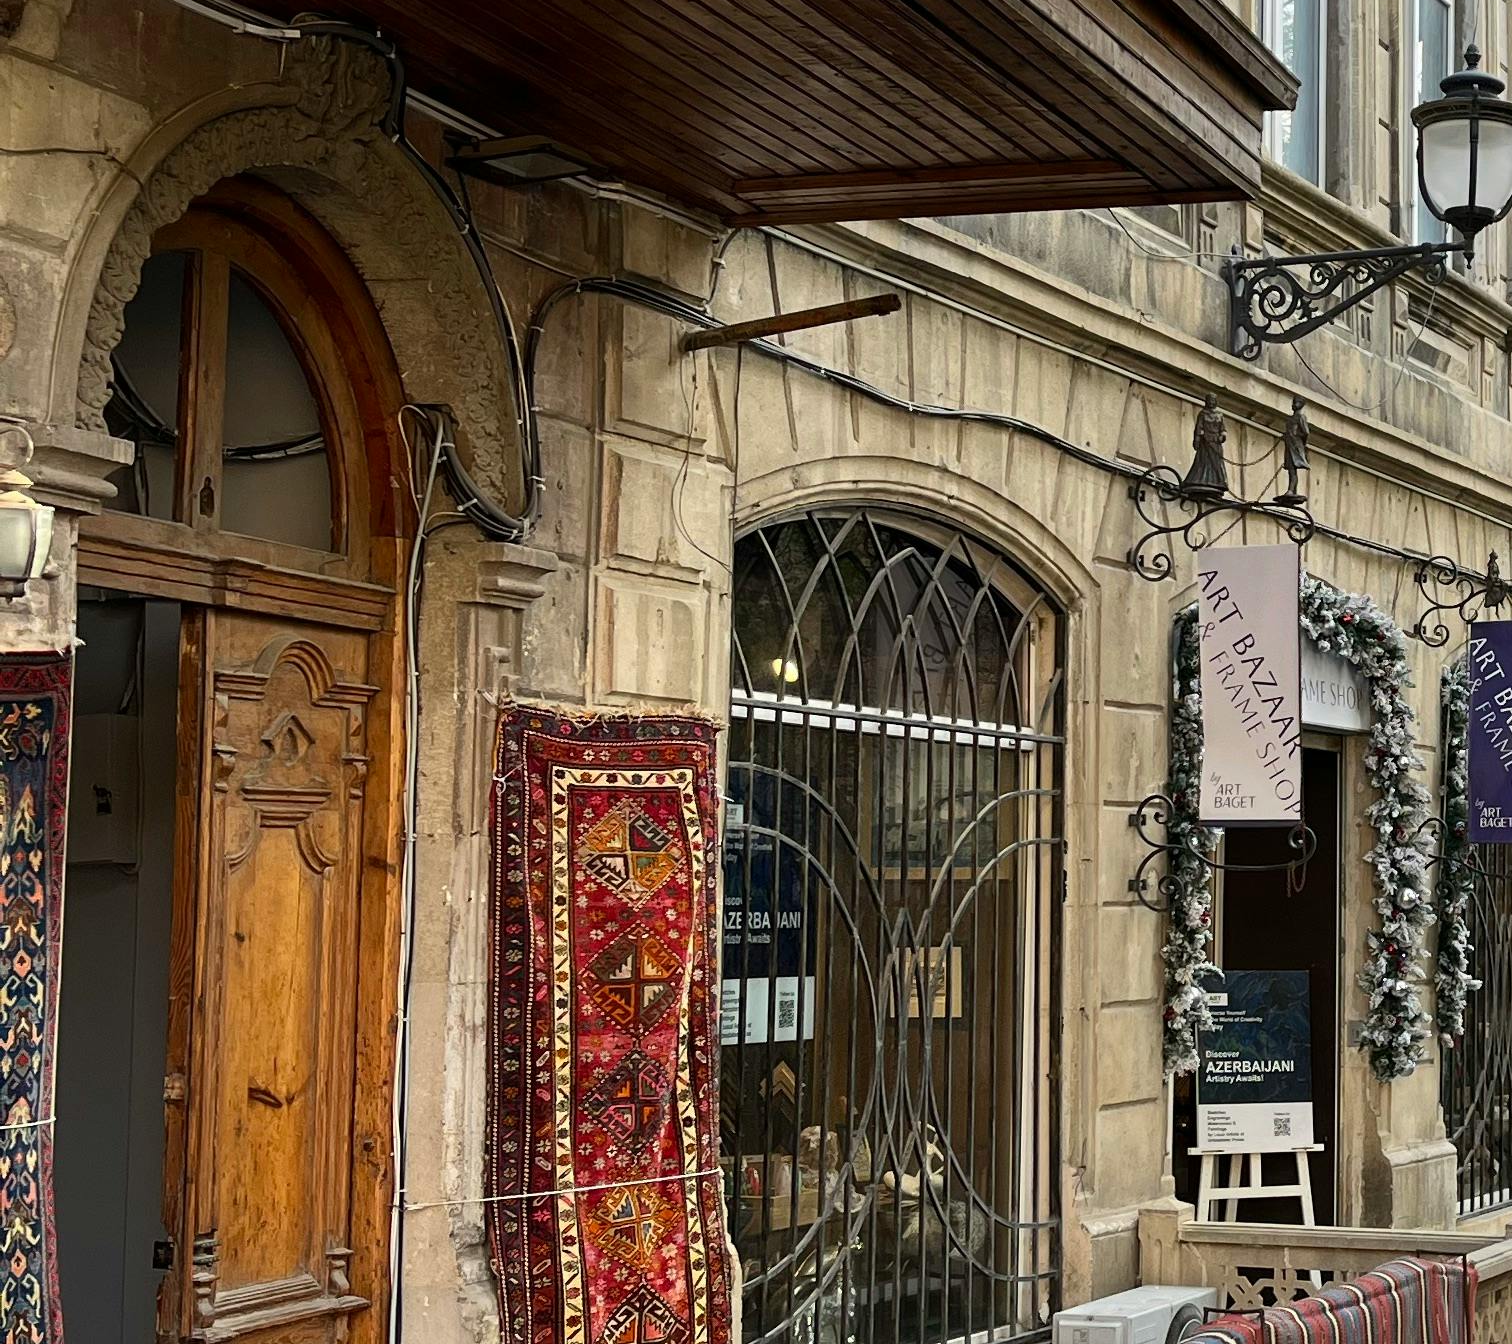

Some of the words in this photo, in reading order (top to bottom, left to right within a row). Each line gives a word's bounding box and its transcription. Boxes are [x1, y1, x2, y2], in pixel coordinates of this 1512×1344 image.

[1198, 570, 1244, 626] ART
[1468, 637, 1505, 681] ART
[1199, 622, 1216, 641] &
[1209, 651, 1266, 738] FRAME
[1470, 678, 1482, 694] &
[1216, 784, 1241, 795] ART
[1214, 796, 1255, 808] BAGET
[1480, 807, 1502, 817] ART
[1205, 1050, 1240, 1058] Discover
[1205, 1060, 1295, 1074] AZERBAIJANI
[1205, 1075, 1235, 1084] Artistry
